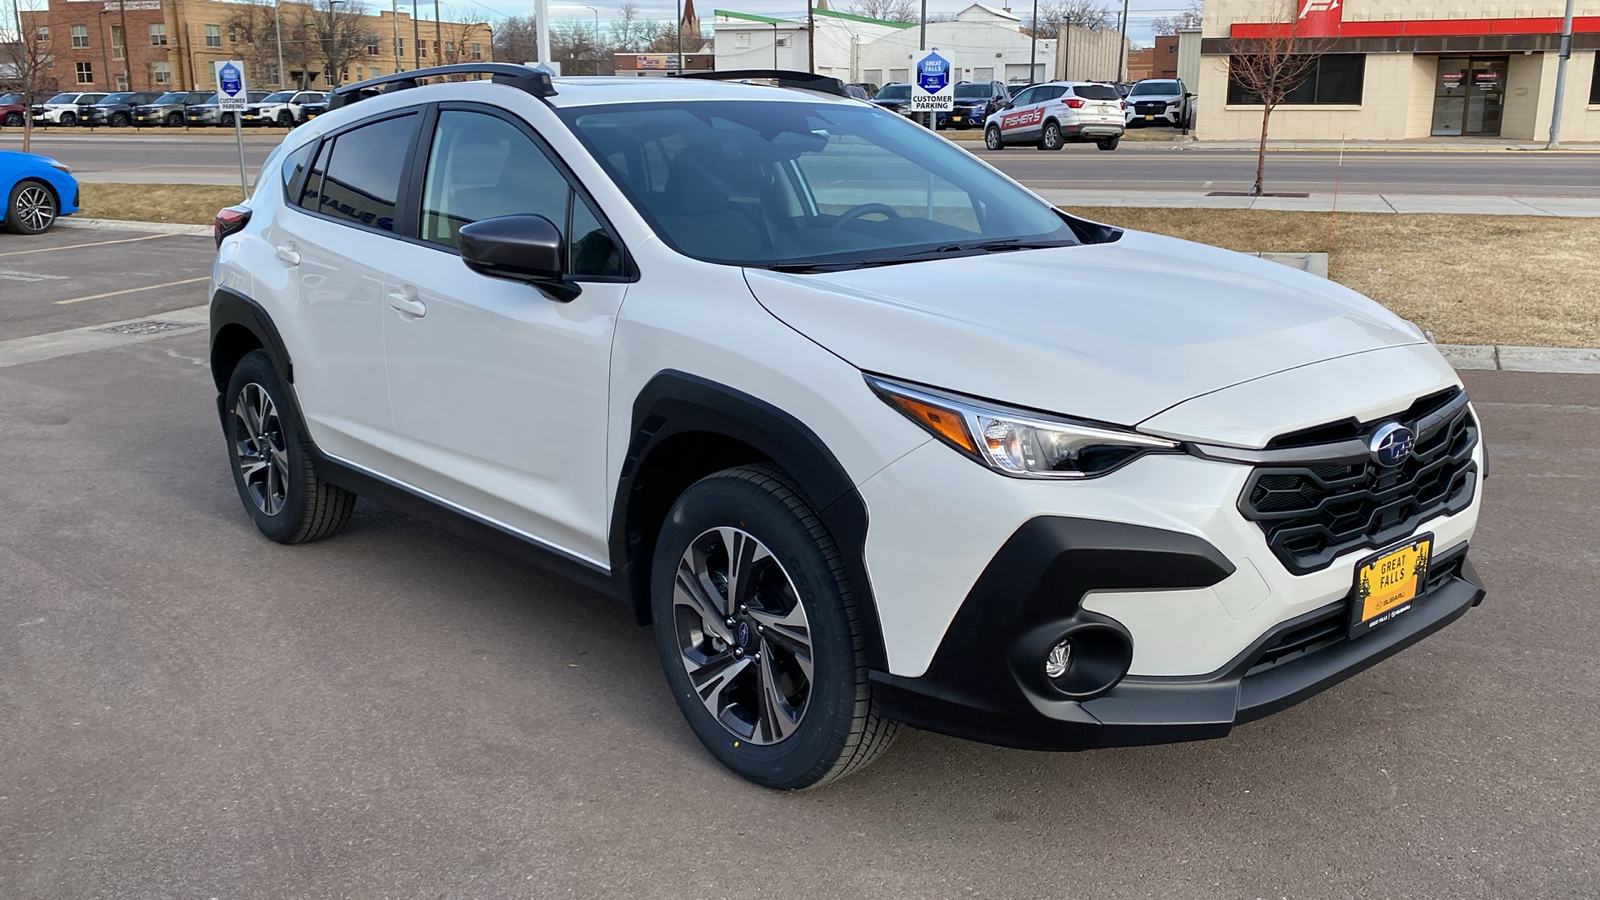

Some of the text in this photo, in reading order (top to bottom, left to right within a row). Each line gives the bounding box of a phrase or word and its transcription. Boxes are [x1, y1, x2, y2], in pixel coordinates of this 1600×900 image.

[912, 95, 953, 103] CUSTOMER
[1004, 109, 1041, 127] FISHER'S
[1381, 554, 1406, 575] GREAT
[1380, 568, 1405, 589] FALLS
[1383, 592, 1405, 606] SUBARU
